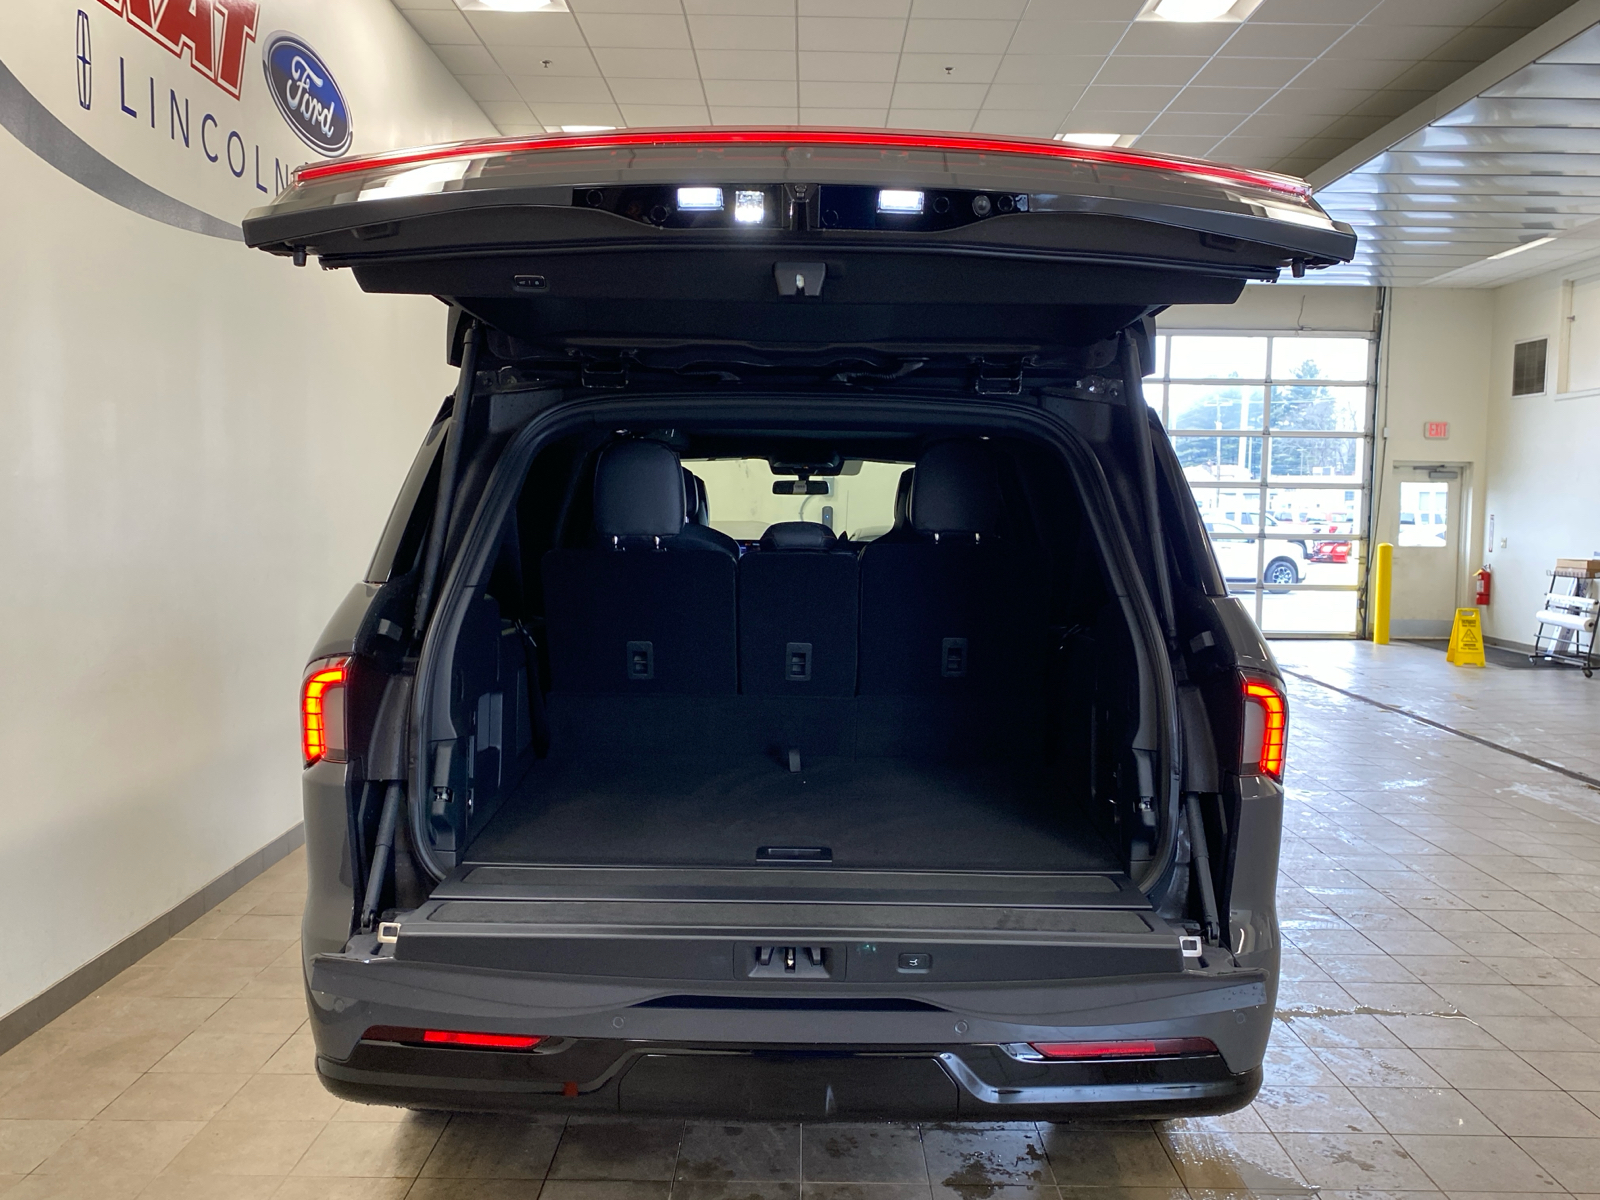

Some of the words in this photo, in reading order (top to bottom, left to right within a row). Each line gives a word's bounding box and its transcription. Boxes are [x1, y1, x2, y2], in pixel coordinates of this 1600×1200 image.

[120, 57, 289, 197] LINCOLN
[286, 55, 335, 138] Ford
[1429, 421, 1448, 437] EXIT
